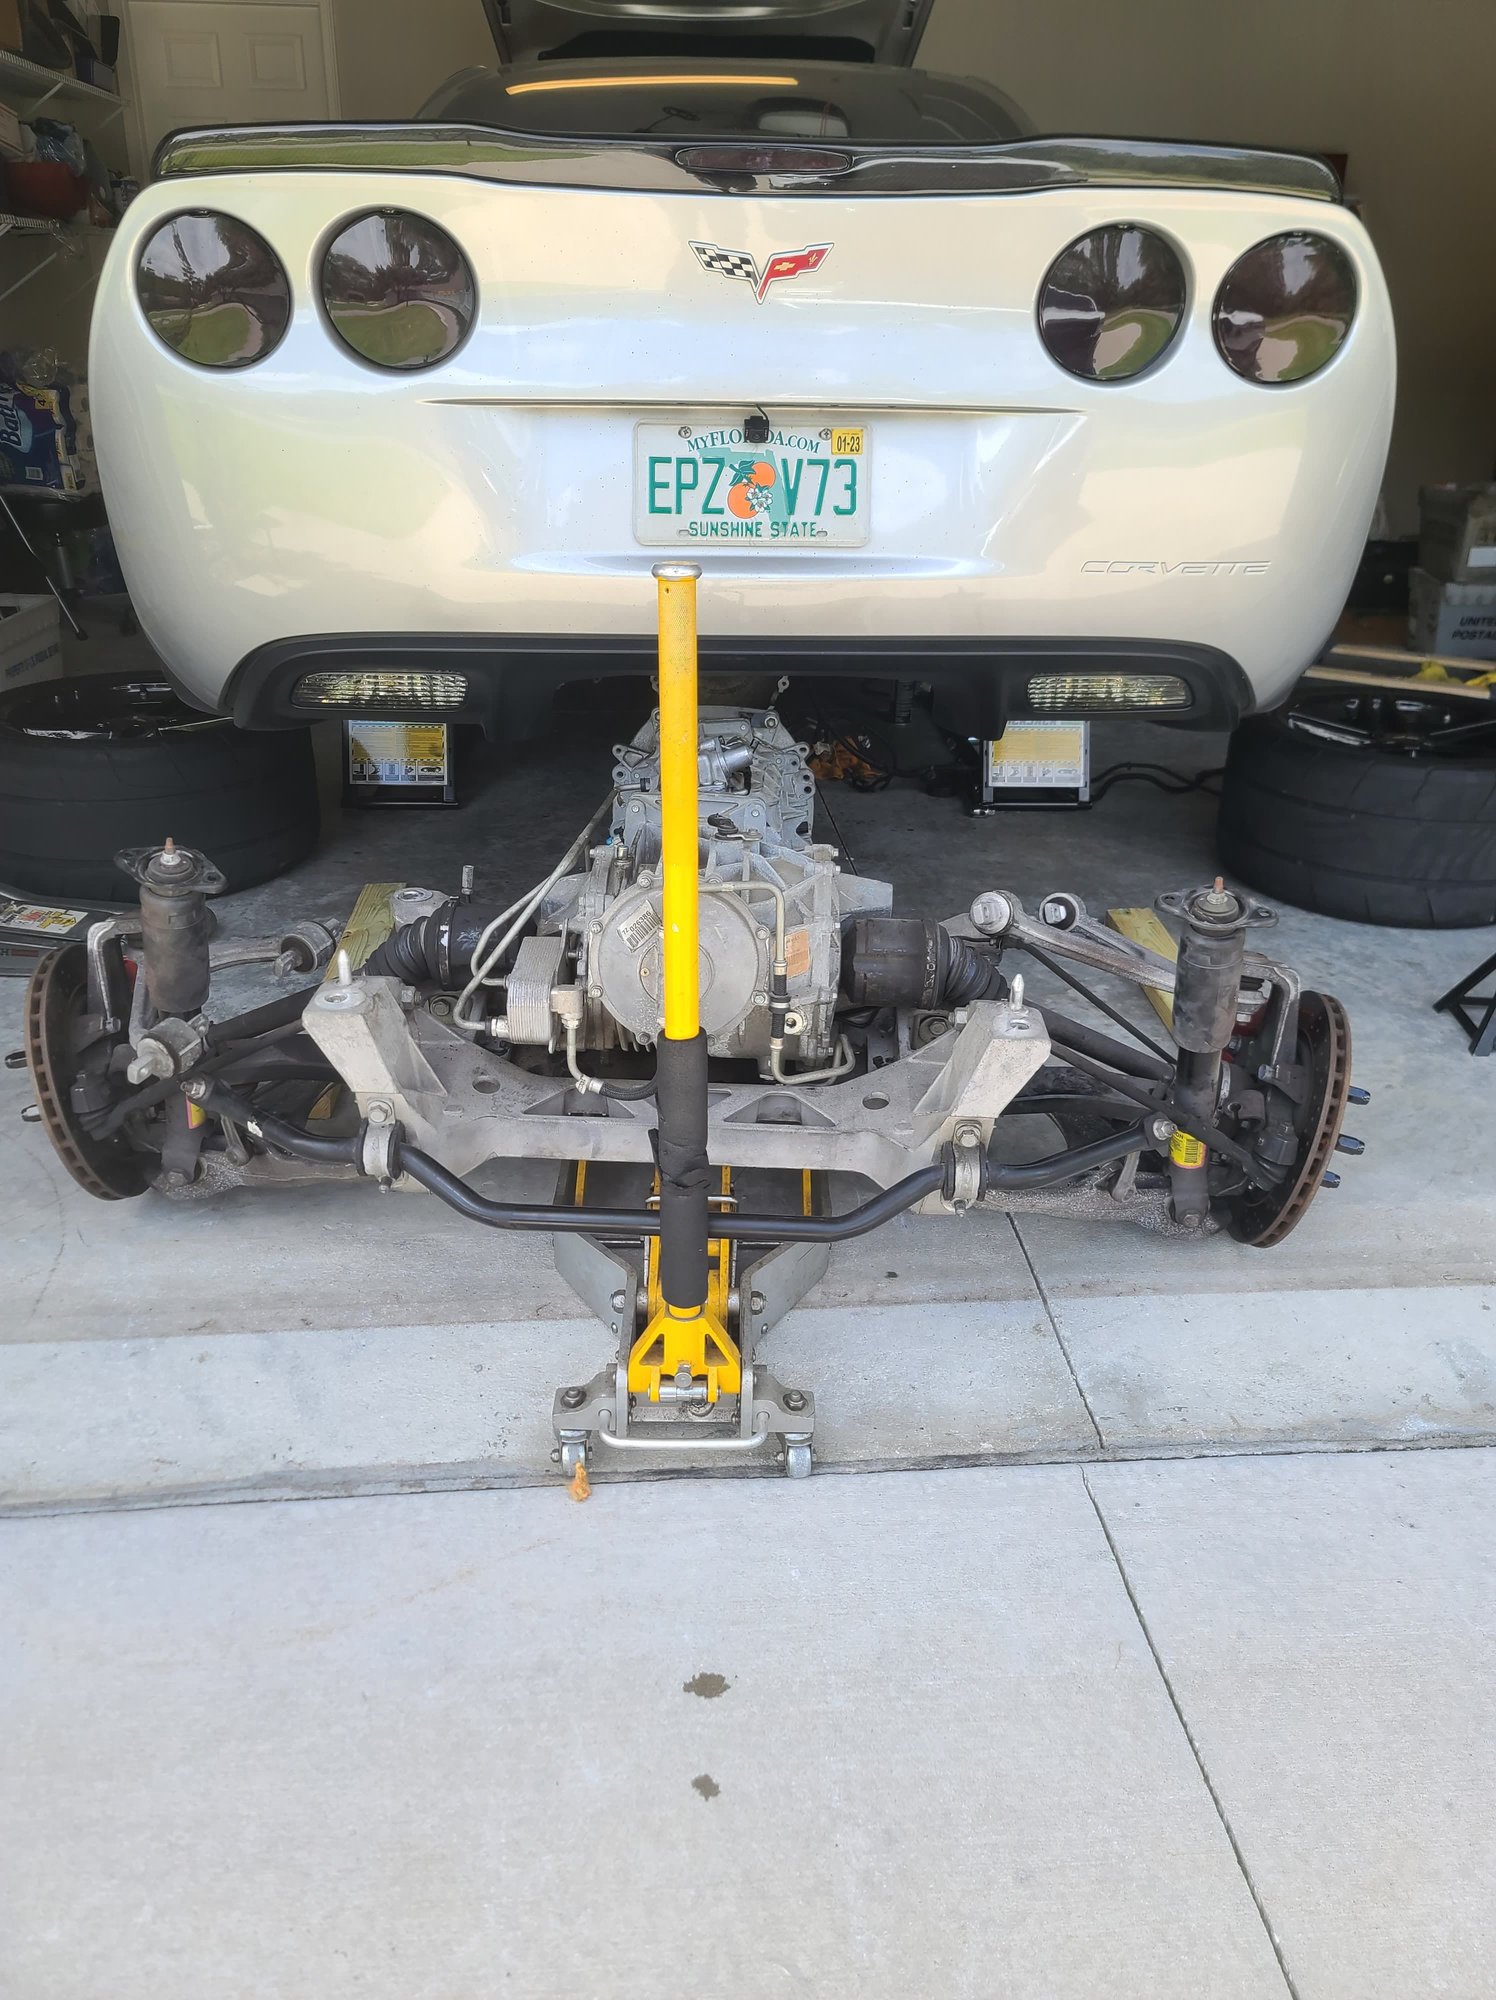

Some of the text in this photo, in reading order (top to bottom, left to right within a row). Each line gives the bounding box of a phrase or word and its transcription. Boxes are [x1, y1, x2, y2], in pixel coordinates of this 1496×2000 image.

[687, 428, 820, 453] MYFLOA.COM
[836, 435, 861, 453] 01-23
[648, 456, 857, 516] EPZ V73
[689, 521, 817, 538] SUNSHINE STATE
[1080, 560, 1272, 576] CORVETTE
[1459, 616, 1496, 627] UNITE
